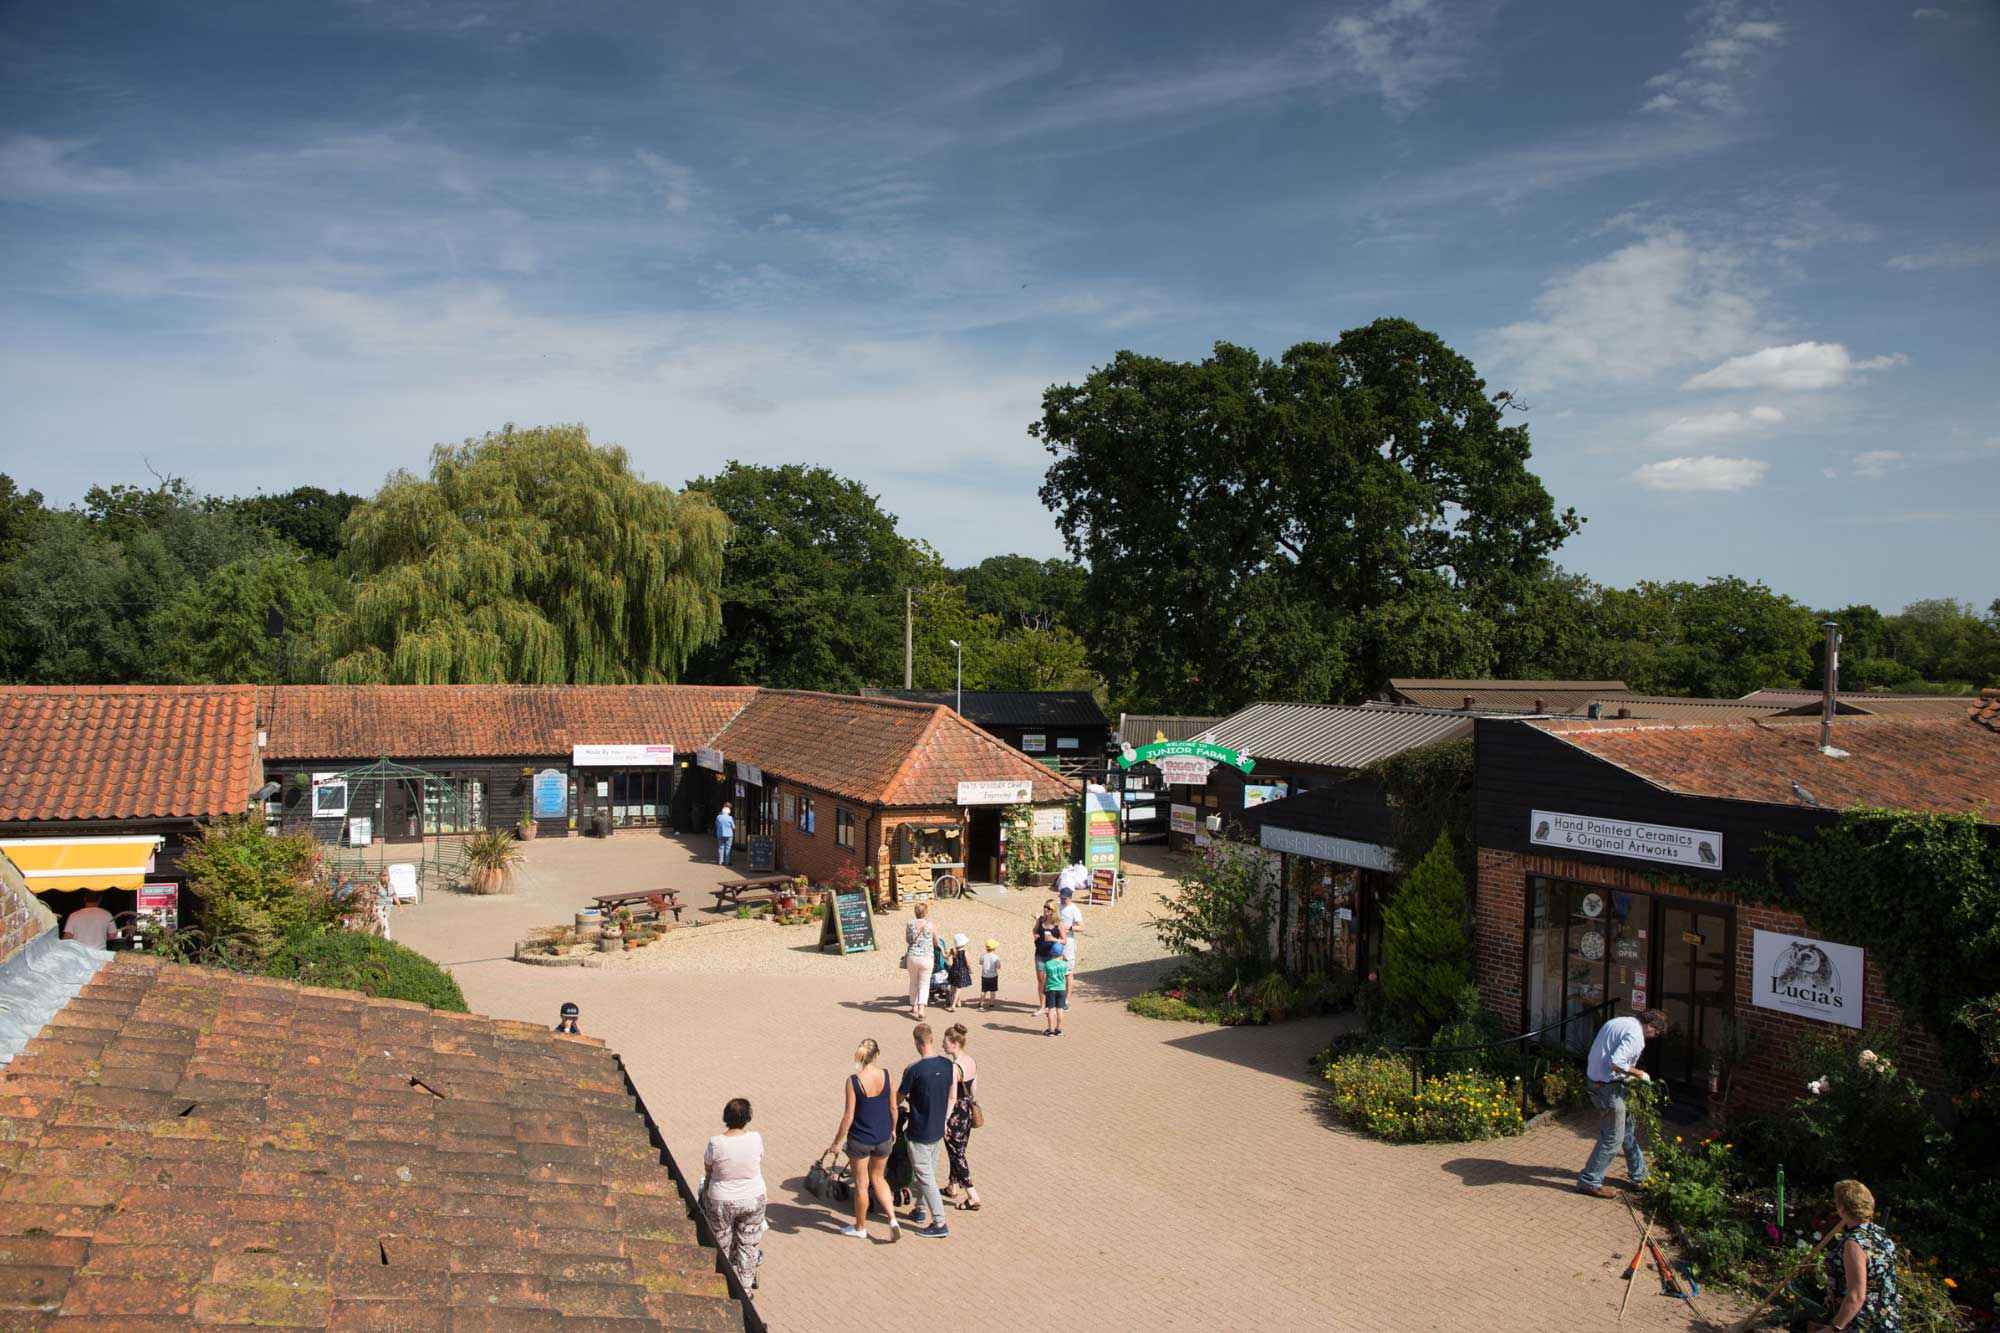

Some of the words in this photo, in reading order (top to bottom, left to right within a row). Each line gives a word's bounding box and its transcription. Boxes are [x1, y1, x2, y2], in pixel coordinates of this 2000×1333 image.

[1146, 747, 1192, 759] JUNIOR
[1196, 748, 1227, 761] FARM
[1555, 817, 1584, 831] Hand
[1587, 821, 1632, 837] Painted
[1635, 828, 1693, 845] Ceramics
[1316, 839, 1367, 865] Stained
[1565, 832, 1574, 843] &
[1578, 834, 1624, 850] Original
[1629, 840, 1679, 857] Artworks
[1770, 975, 1843, 1008] Lucia's
